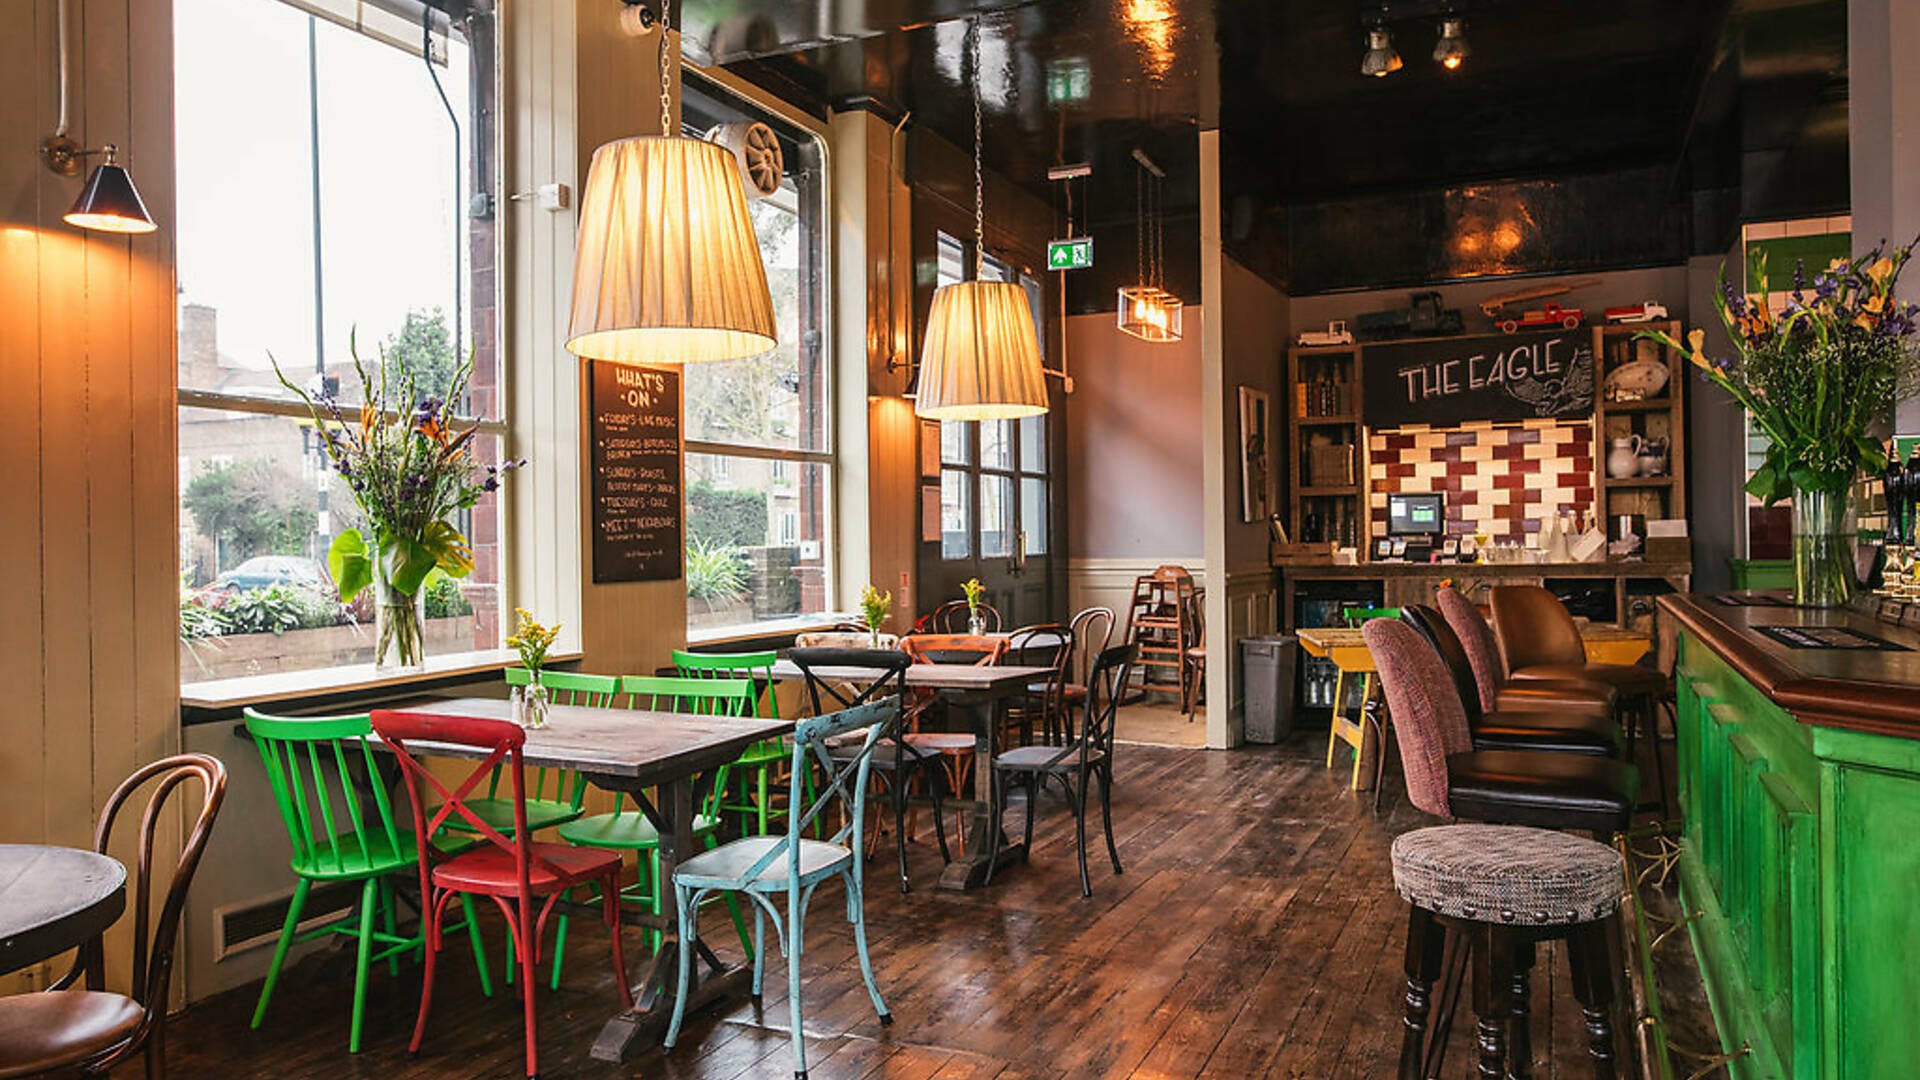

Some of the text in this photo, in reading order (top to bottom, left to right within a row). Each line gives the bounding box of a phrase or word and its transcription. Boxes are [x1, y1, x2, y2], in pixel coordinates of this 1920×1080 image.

[616, 367, 665, 393] WHAT'S
[1398, 338, 1562, 403] THE EAGLE
[627, 390, 650, 408] ON
